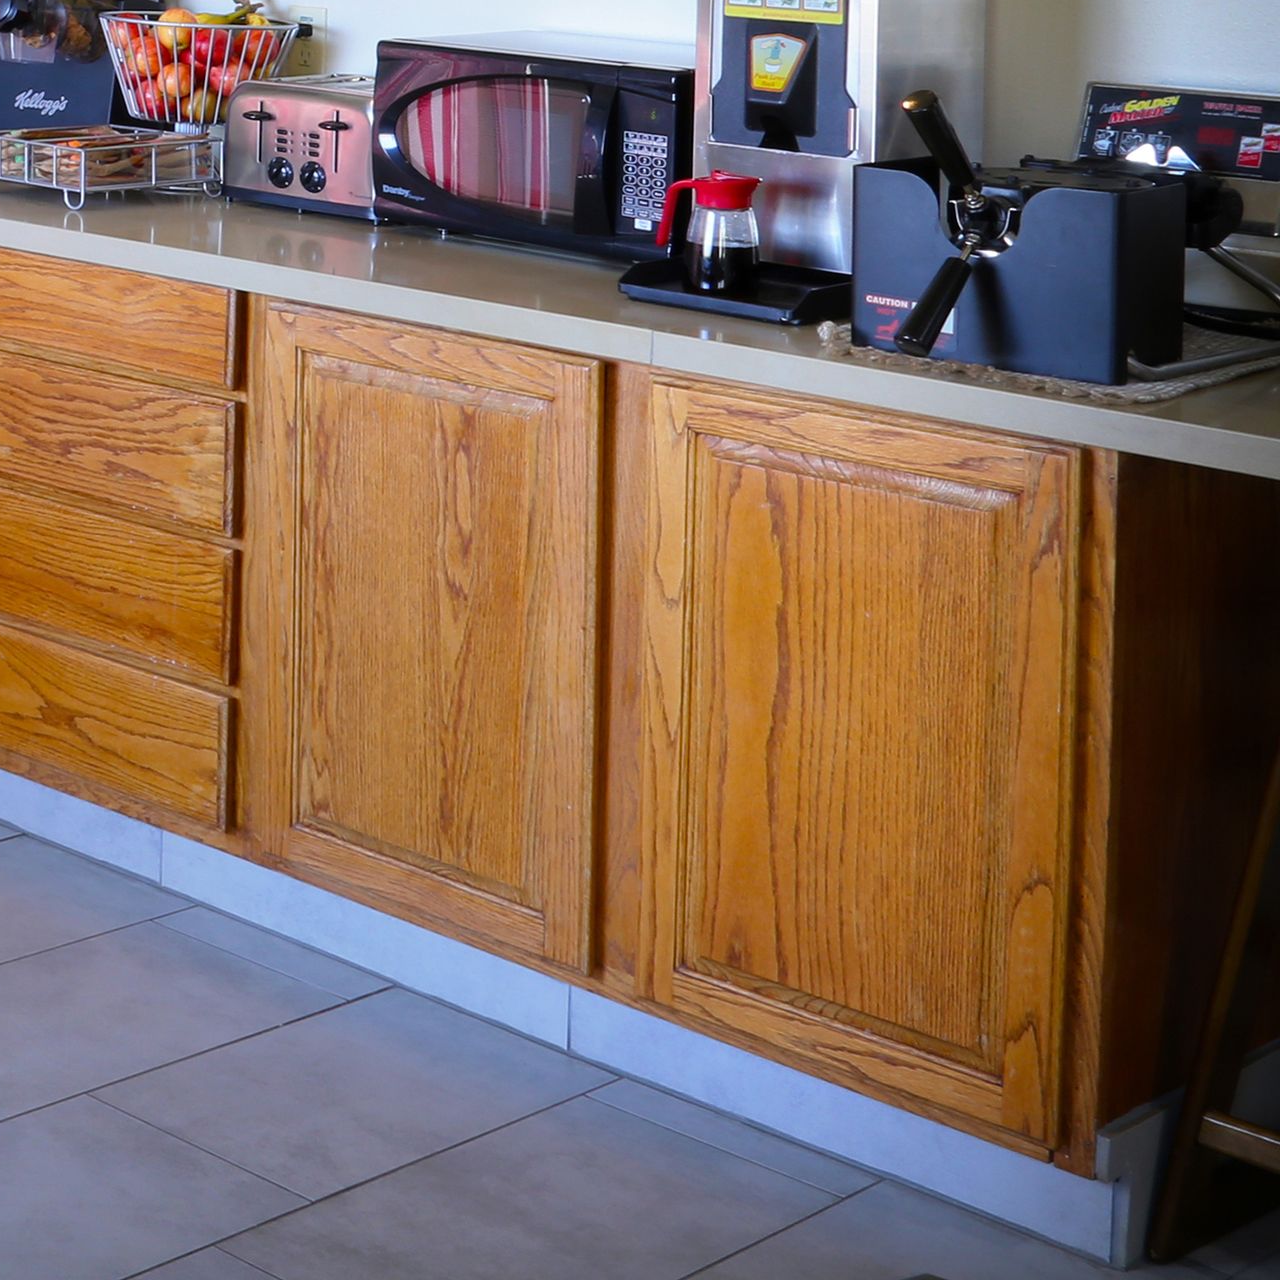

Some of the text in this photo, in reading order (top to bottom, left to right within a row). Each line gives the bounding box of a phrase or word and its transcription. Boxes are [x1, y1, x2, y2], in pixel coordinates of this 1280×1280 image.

[14, 89, 68, 116] Kellogg's
[1124, 95, 1181, 113] GOLDEN
[865, 295, 908, 309] CAUTION
